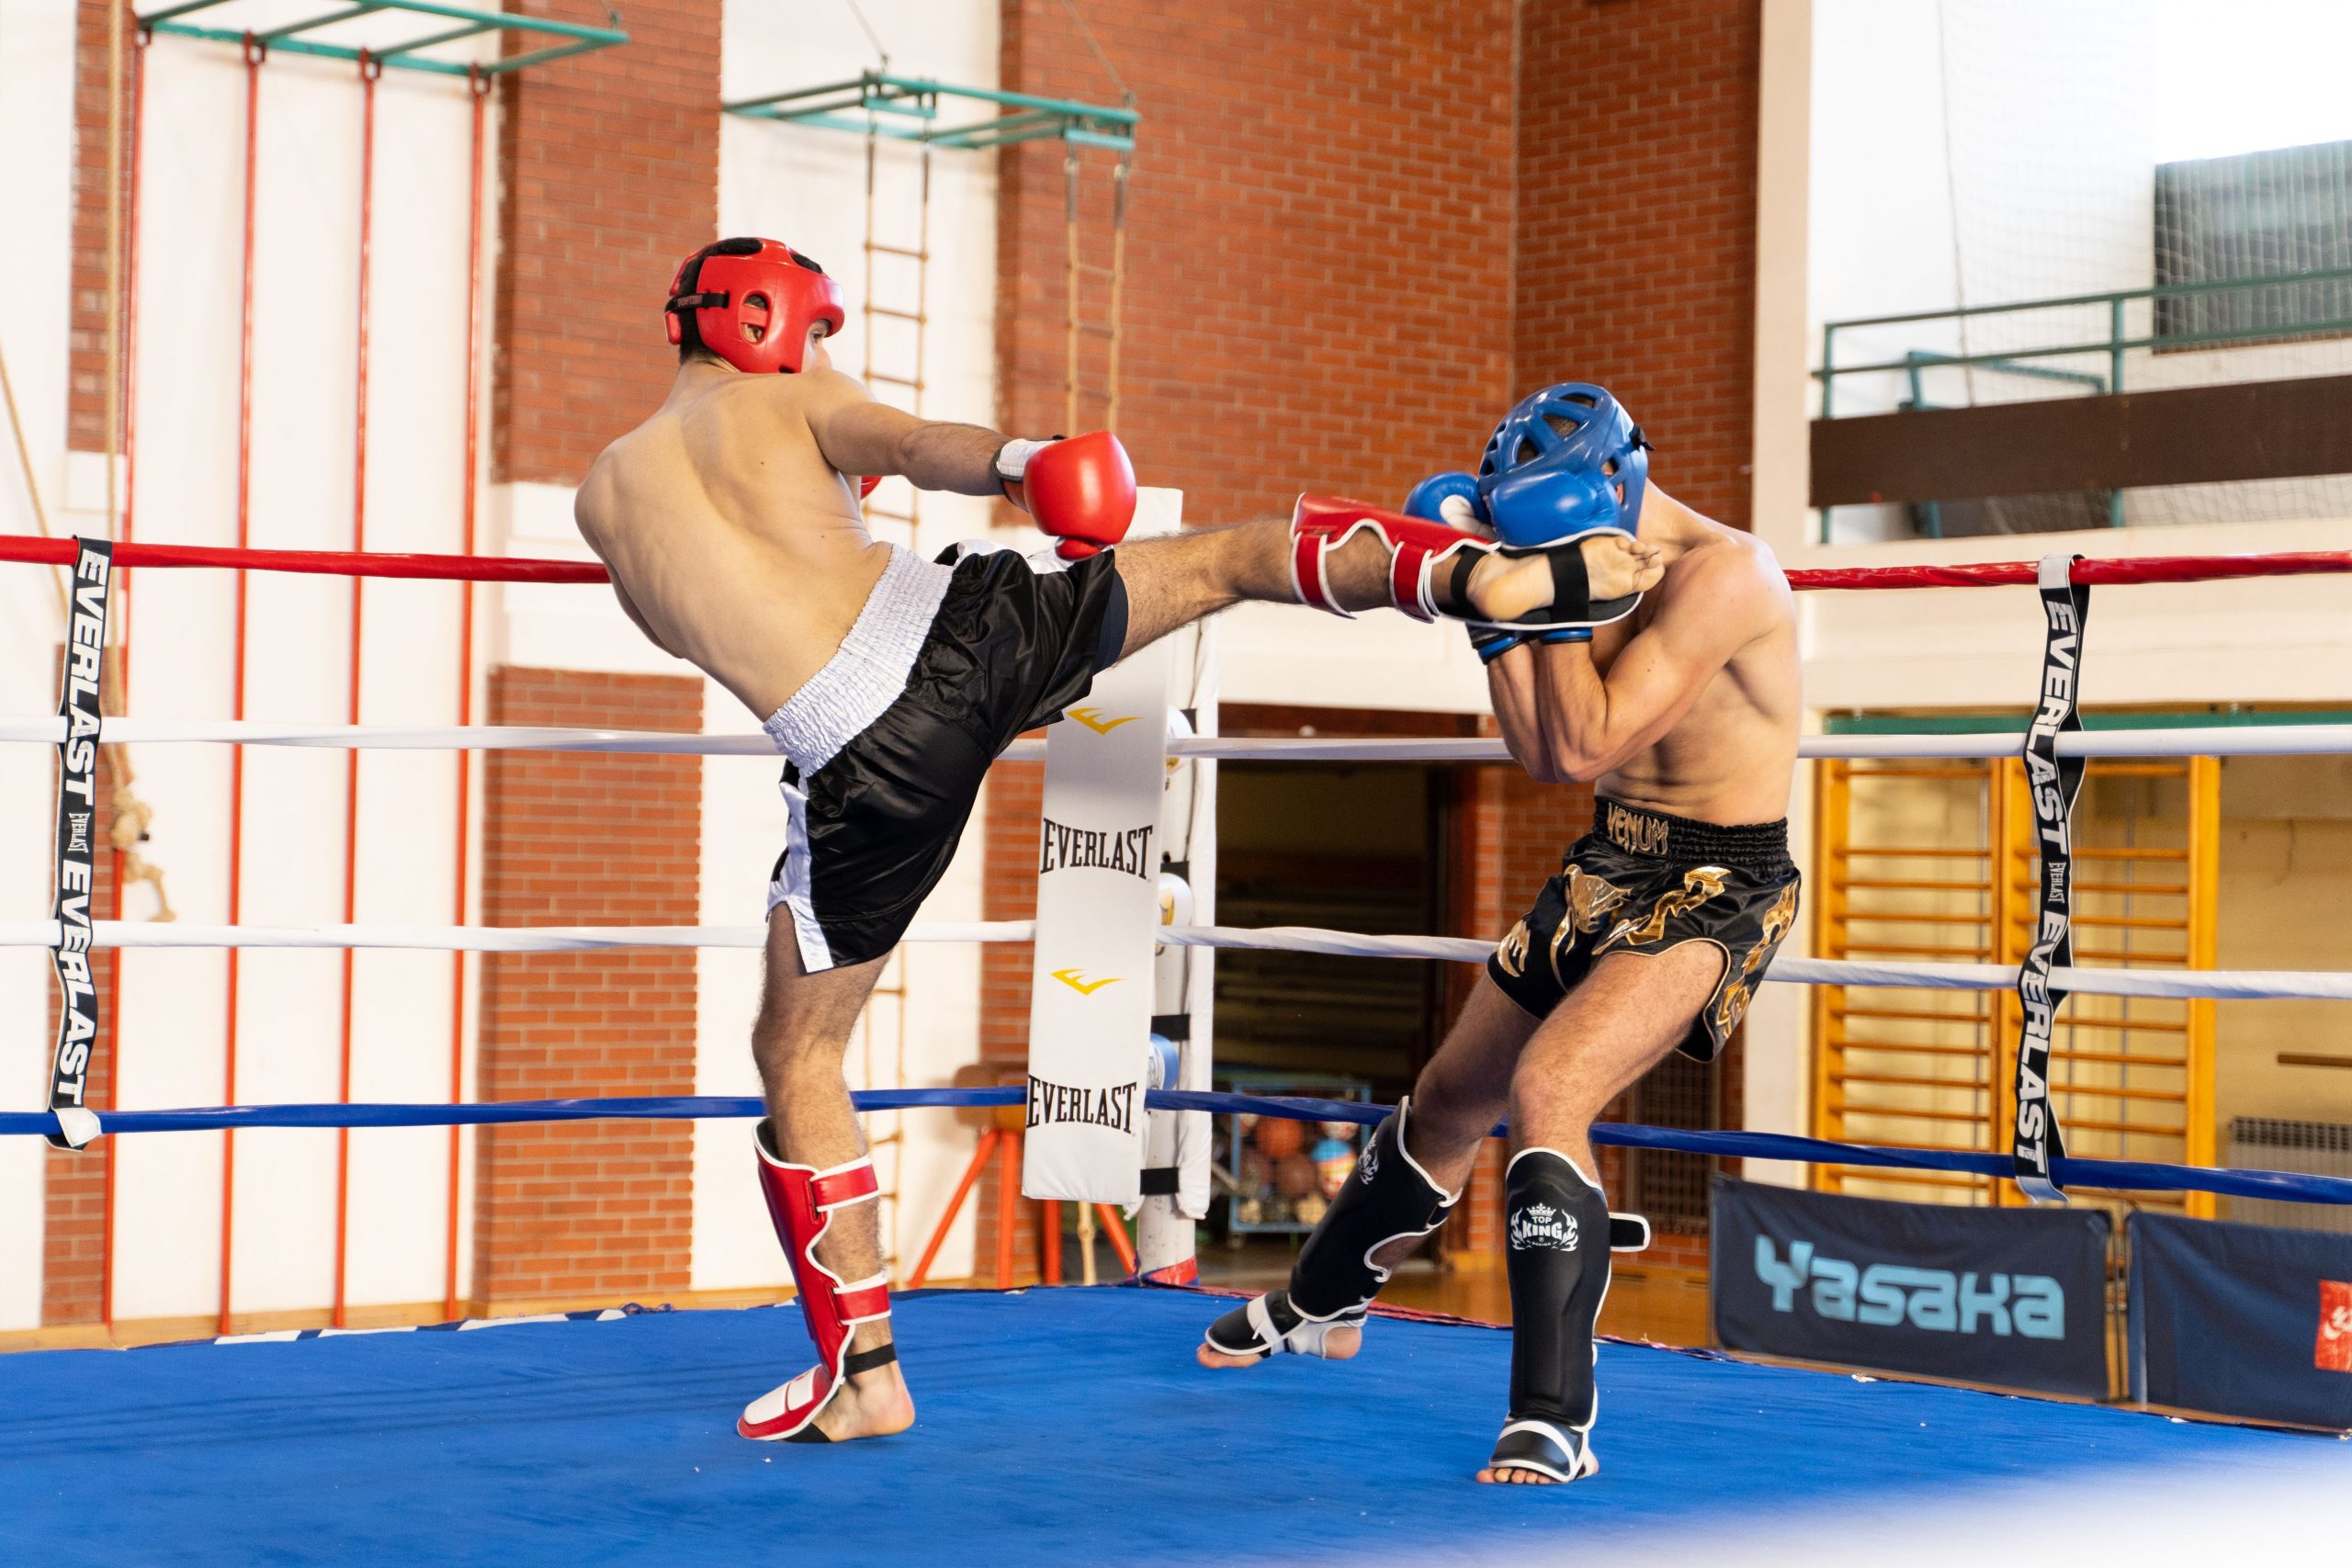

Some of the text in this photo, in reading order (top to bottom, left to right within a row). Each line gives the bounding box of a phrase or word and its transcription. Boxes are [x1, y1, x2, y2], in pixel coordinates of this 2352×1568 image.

[65, 548, 109, 806] EVERLAST
[2026, 600, 2077, 854] EVERLAST
[68, 812, 91, 854] EVERLAST
[1040, 817, 1154, 880] EVERLAST
[1607, 802, 1669, 855] VENUM
[2048, 861, 2066, 904] EVERLAST
[57, 859, 95, 1105] EVERLAST
[2017, 909, 2067, 1174] EVERLAST
[1026, 1073, 1137, 1135] EVERLAST
[1522, 1220, 1563, 1240] KING
[1532, 1216, 1553, 1224] TOP
